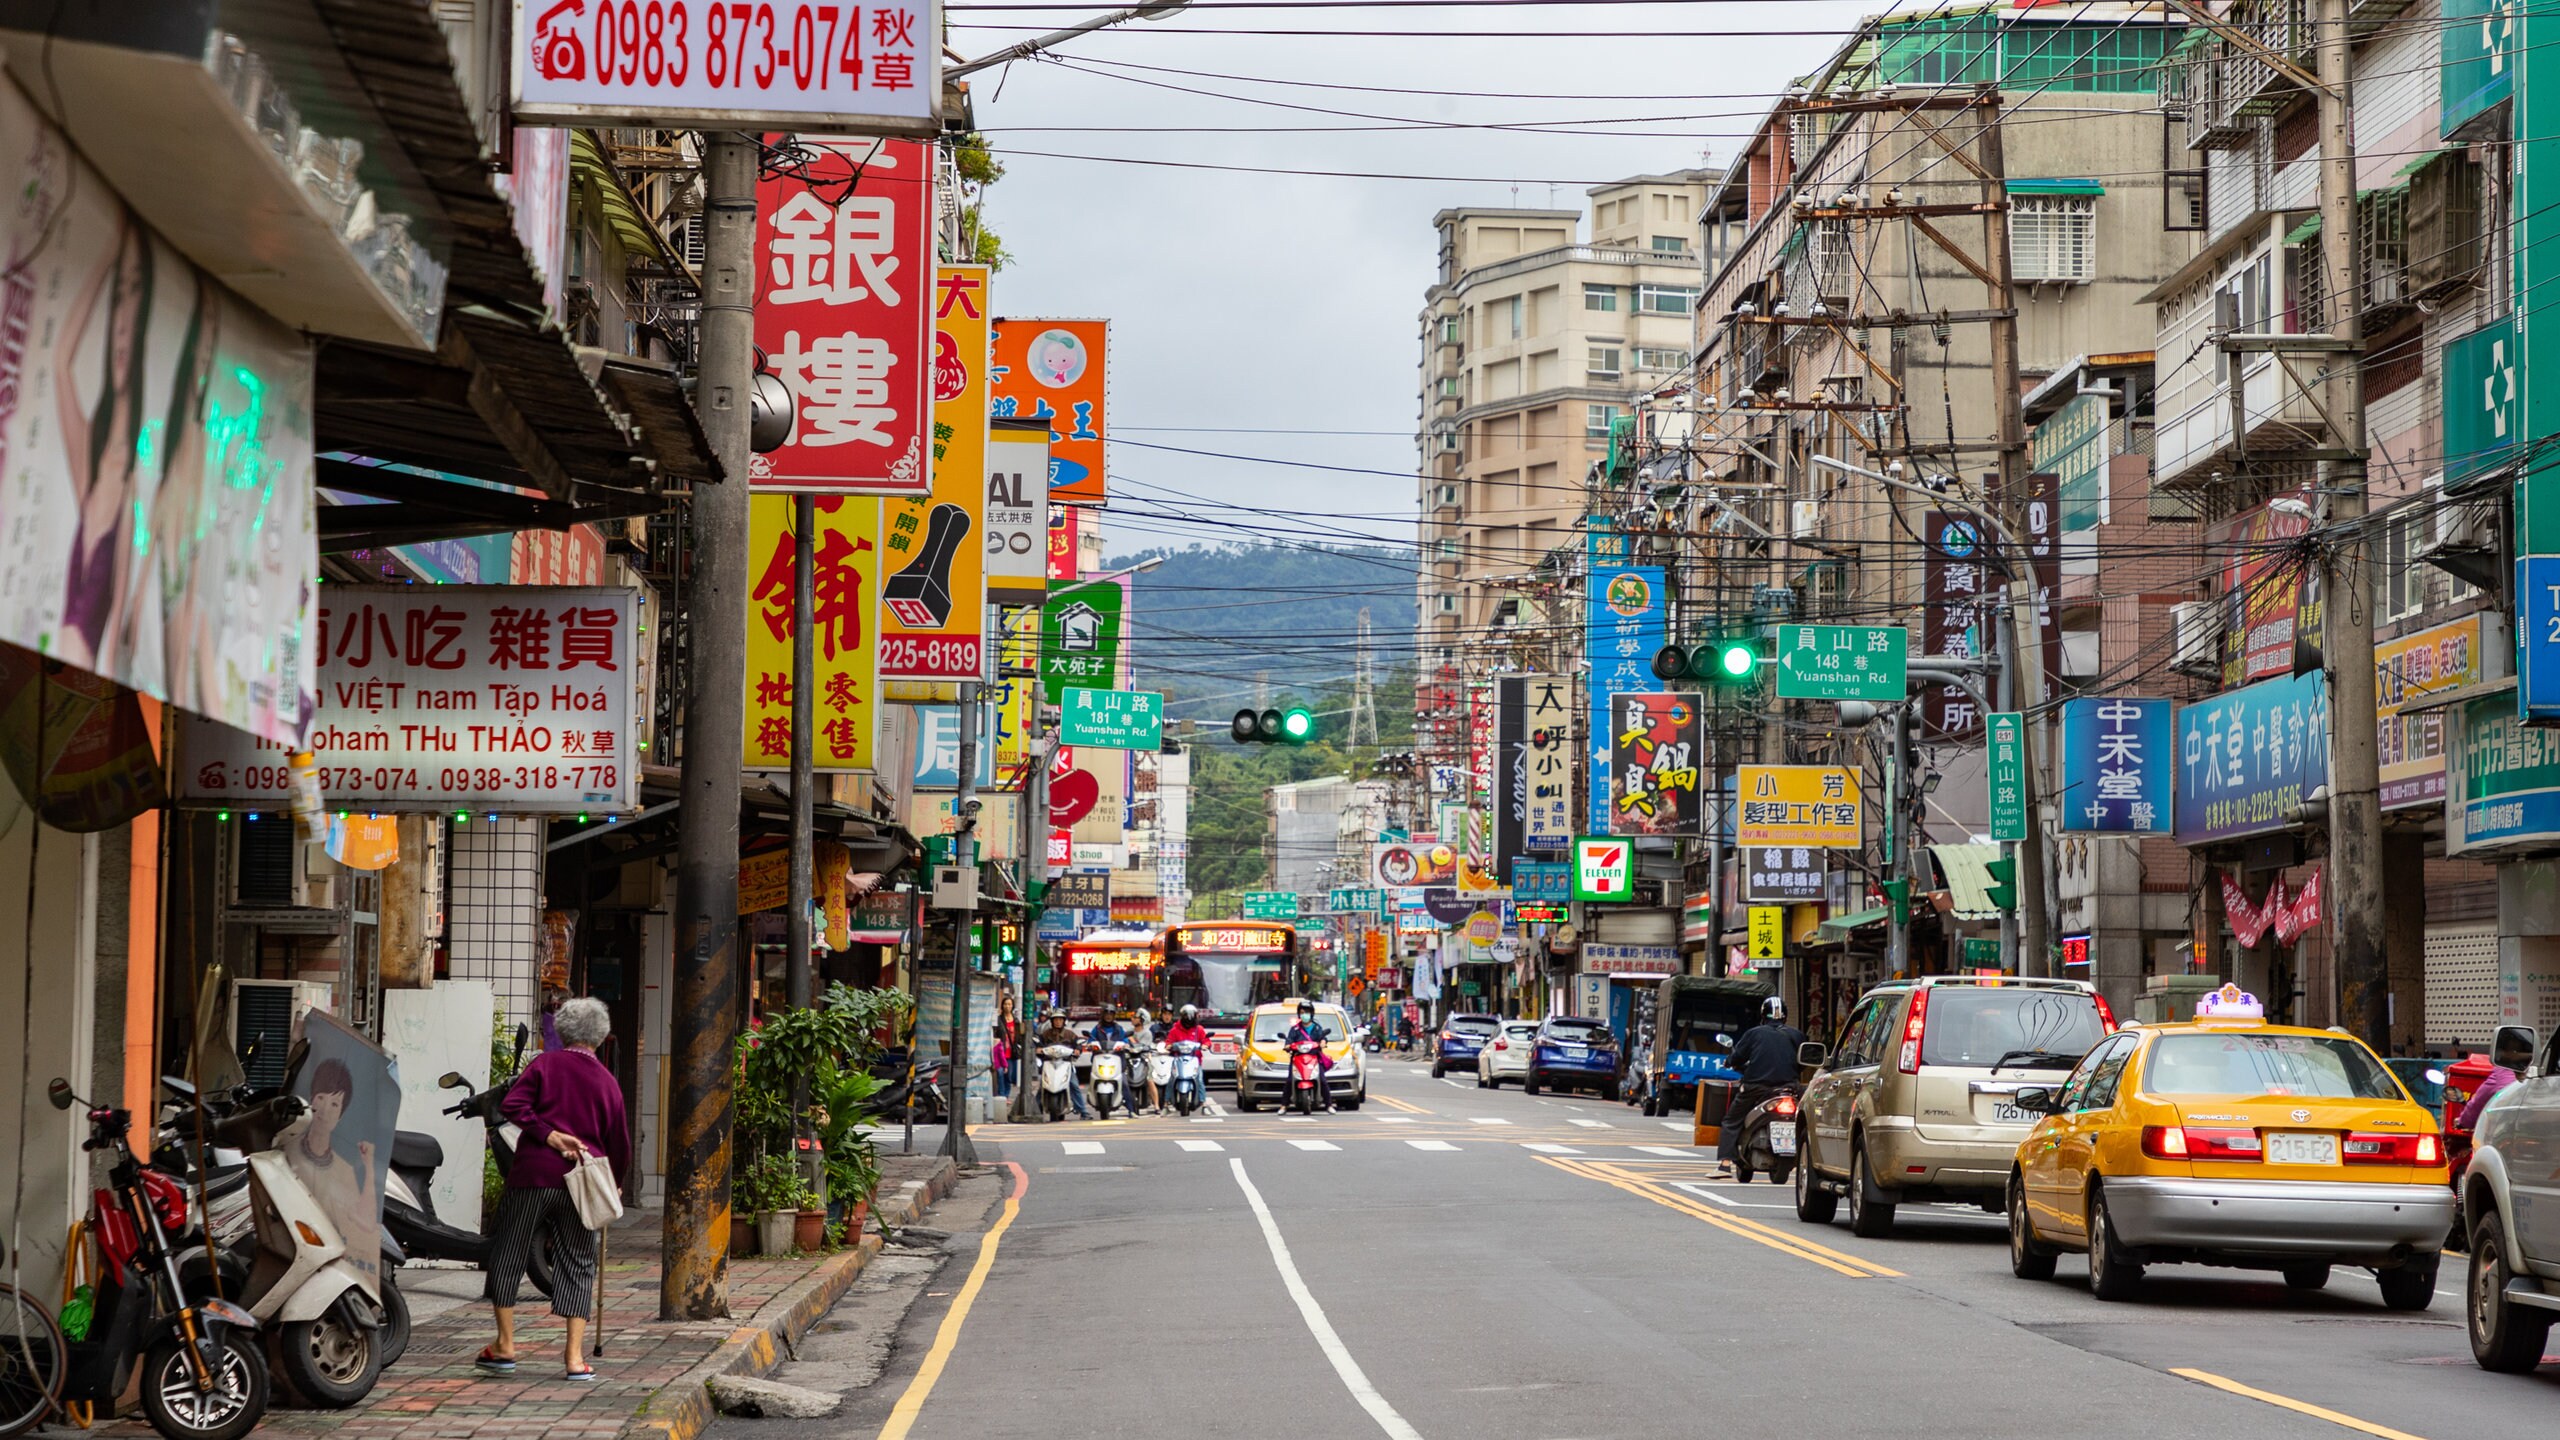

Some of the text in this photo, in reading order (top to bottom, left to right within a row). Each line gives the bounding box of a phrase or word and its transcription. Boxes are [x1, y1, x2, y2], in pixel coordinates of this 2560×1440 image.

[594, 0, 863, 91] 0983 873-074
[871, 8, 915, 91] 秋草
[767, 136, 901, 448] 銀樓
[488, 604, 618, 672] 雜貨
[1614, 618, 1643, 678] 新學成
[1796, 628, 1890, 653] 員山路
[1050, 657, 1105, 676] 大苑子
[1815, 653, 1869, 671] 148 巷
[1795, 669, 1891, 684] Yuanshan Rd.
[2378, 654, 2404, 710] 文理
[417, 690, 477, 710] nam
[1077, 691, 1150, 713] 員山路
[1844, 687, 1861, 696] 148
[755, 672, 793, 759] 批發
[821, 672, 863, 760] 零售
[1090, 711, 1133, 726] 181 巷
[400, 725, 457, 752] THu
[561, 729, 615, 755] 秋草
[1074, 723, 1150, 737] Yuanshan Rd.
[2096, 700, 2144, 801] 中禾堂
[2185, 693, 2325, 799] 中禾堂 中醫診所
[441, 765, 617, 791] 0938-318-778
[1756, 773, 1845, 798] 小芳
[1998, 744, 2016, 804] 員山路
[1532, 806, 1545, 834] 世界
[1744, 801, 1856, 826] 髮型工作室
[1995, 807, 2021, 816] Yuan-
[1995, 816, 2017, 826] shan
[2083, 801, 2157, 831] 中醫
[1752, 872, 1822, 888] 食堂居酒屋
[1218, 930, 1244, 946] 201
[1757, 910, 1774, 945] 土城
[2271, 1138, 2335, 1161] 215-E2
